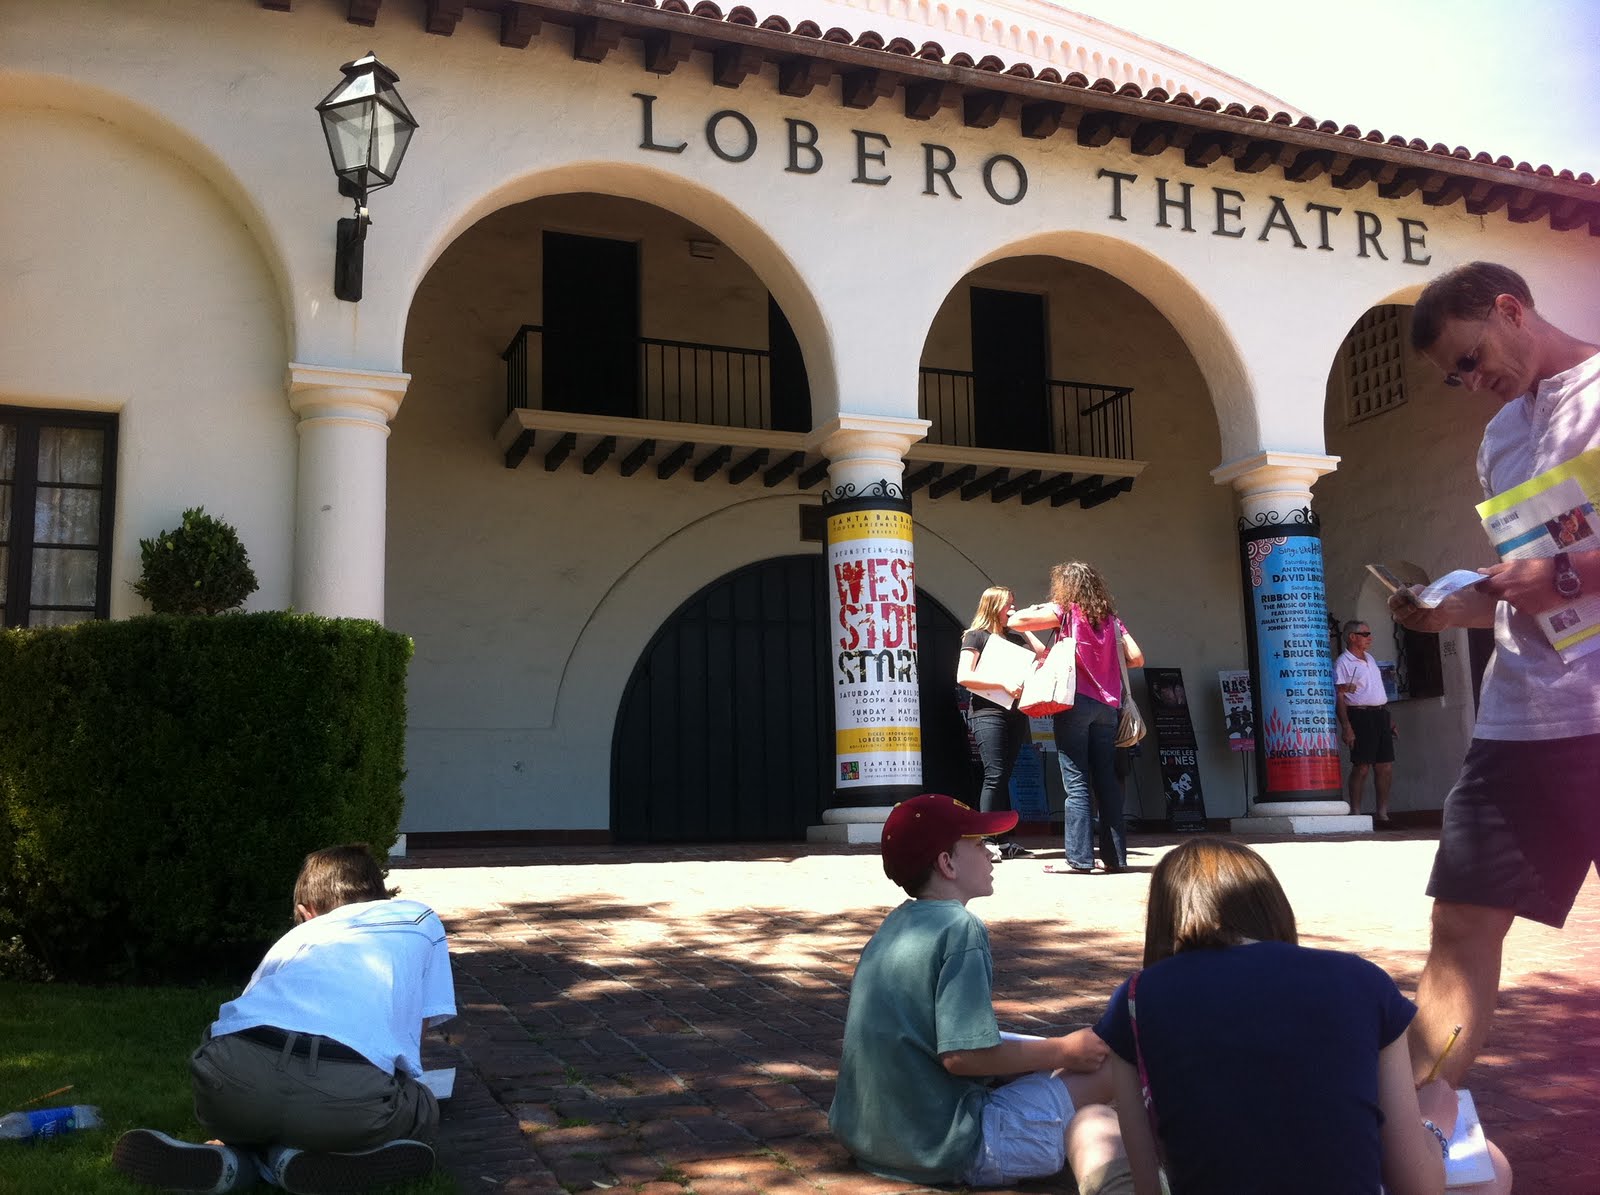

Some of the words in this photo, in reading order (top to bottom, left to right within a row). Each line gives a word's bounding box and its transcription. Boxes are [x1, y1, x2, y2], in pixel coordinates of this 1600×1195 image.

[632, 93, 1028, 206] LOBERO
[1098, 168, 1432, 265] THEATRE
[833, 514, 869, 525] SANTA
[1272, 574, 1305, 583] DAVID
[1261, 592, 1298, 603] RIBBON
[1300, 592, 1312, 600] OF
[839, 603, 917, 650] SIDE
[1284, 640, 1313, 648] KELLY
[1283, 650, 1314, 658] BRUCE
[1280, 669, 1323, 678] MYSTERY
[840, 689, 880, 698] SATURDAY
[1285, 688, 1305, 697] DEL
[852, 708, 886, 716] SUNDAY
[1290, 716, 1310, 725] THE
